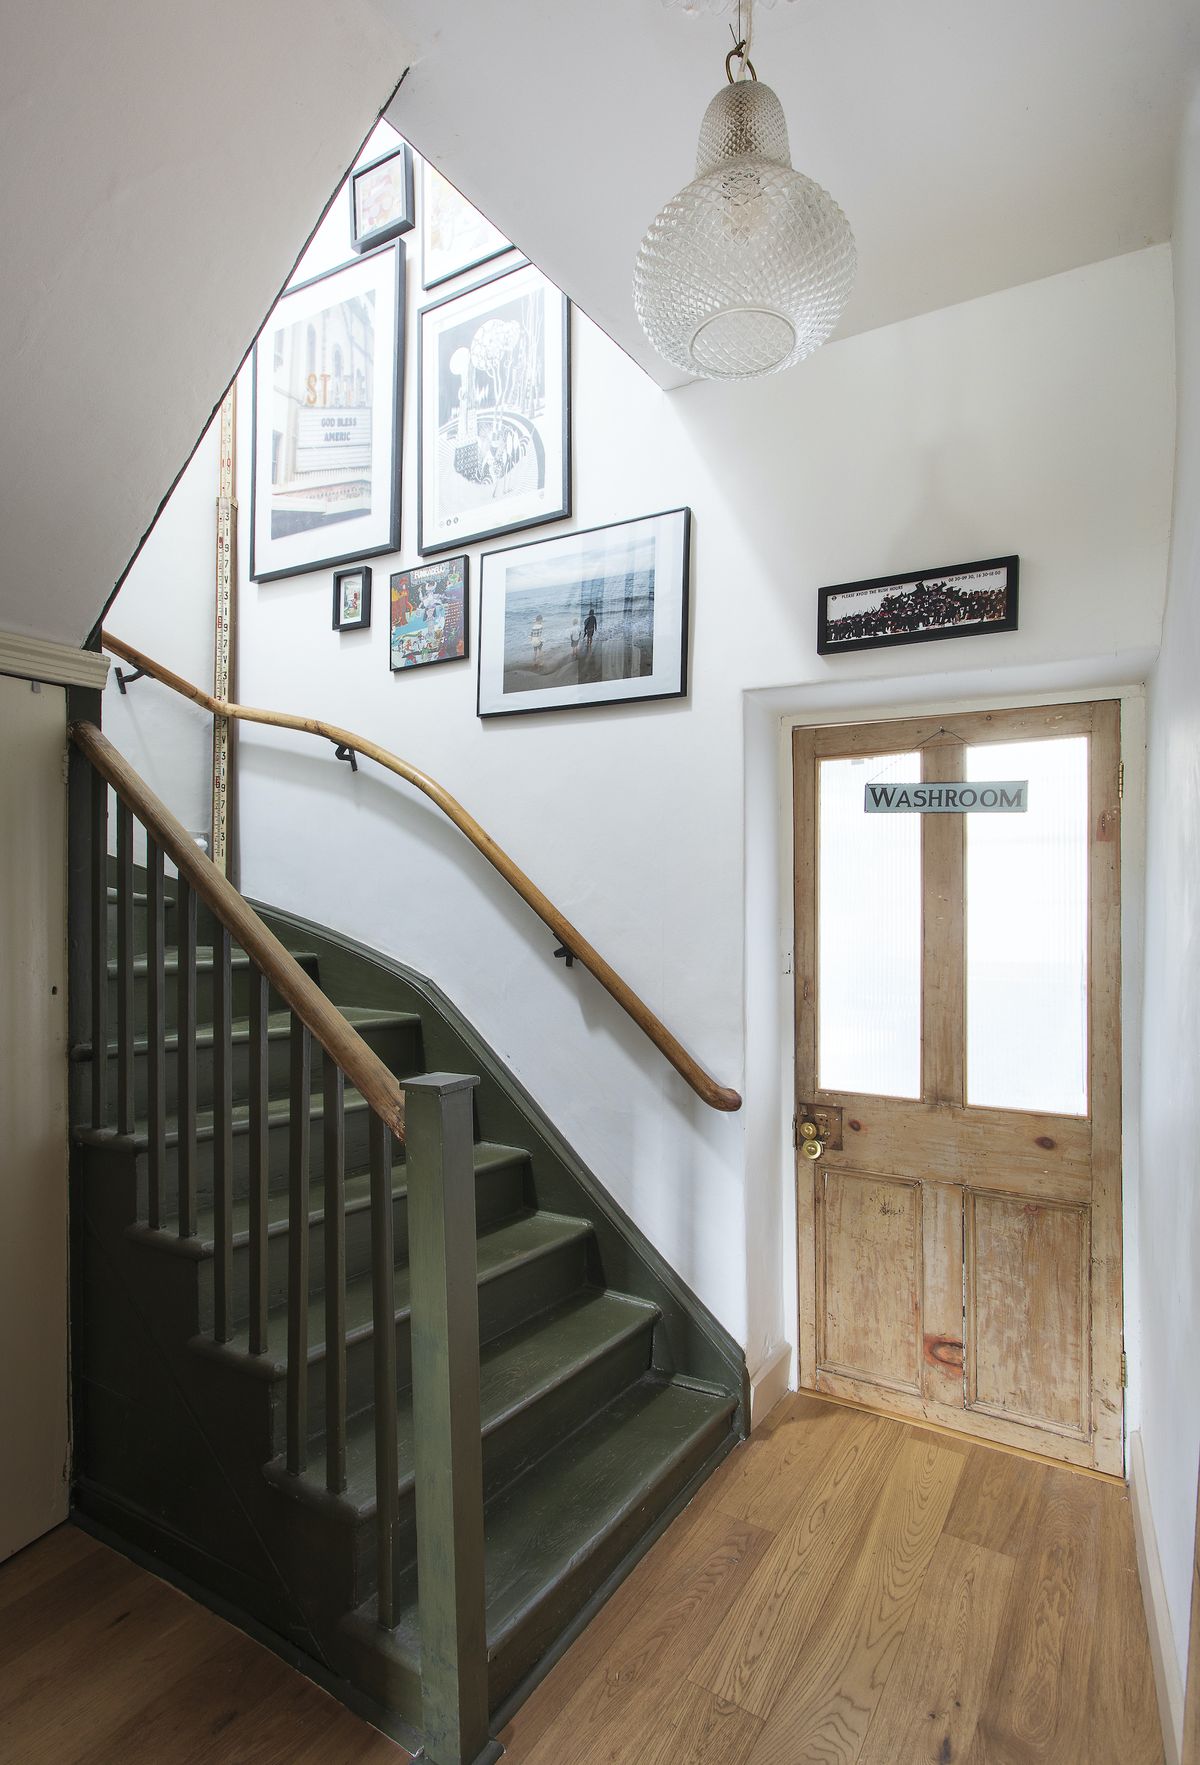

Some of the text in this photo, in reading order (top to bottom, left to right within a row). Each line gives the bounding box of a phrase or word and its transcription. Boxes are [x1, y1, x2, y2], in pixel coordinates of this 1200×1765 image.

[321, 417, 357, 428] GOD BLESS
[869, 787, 1024, 808] WASHROOM
